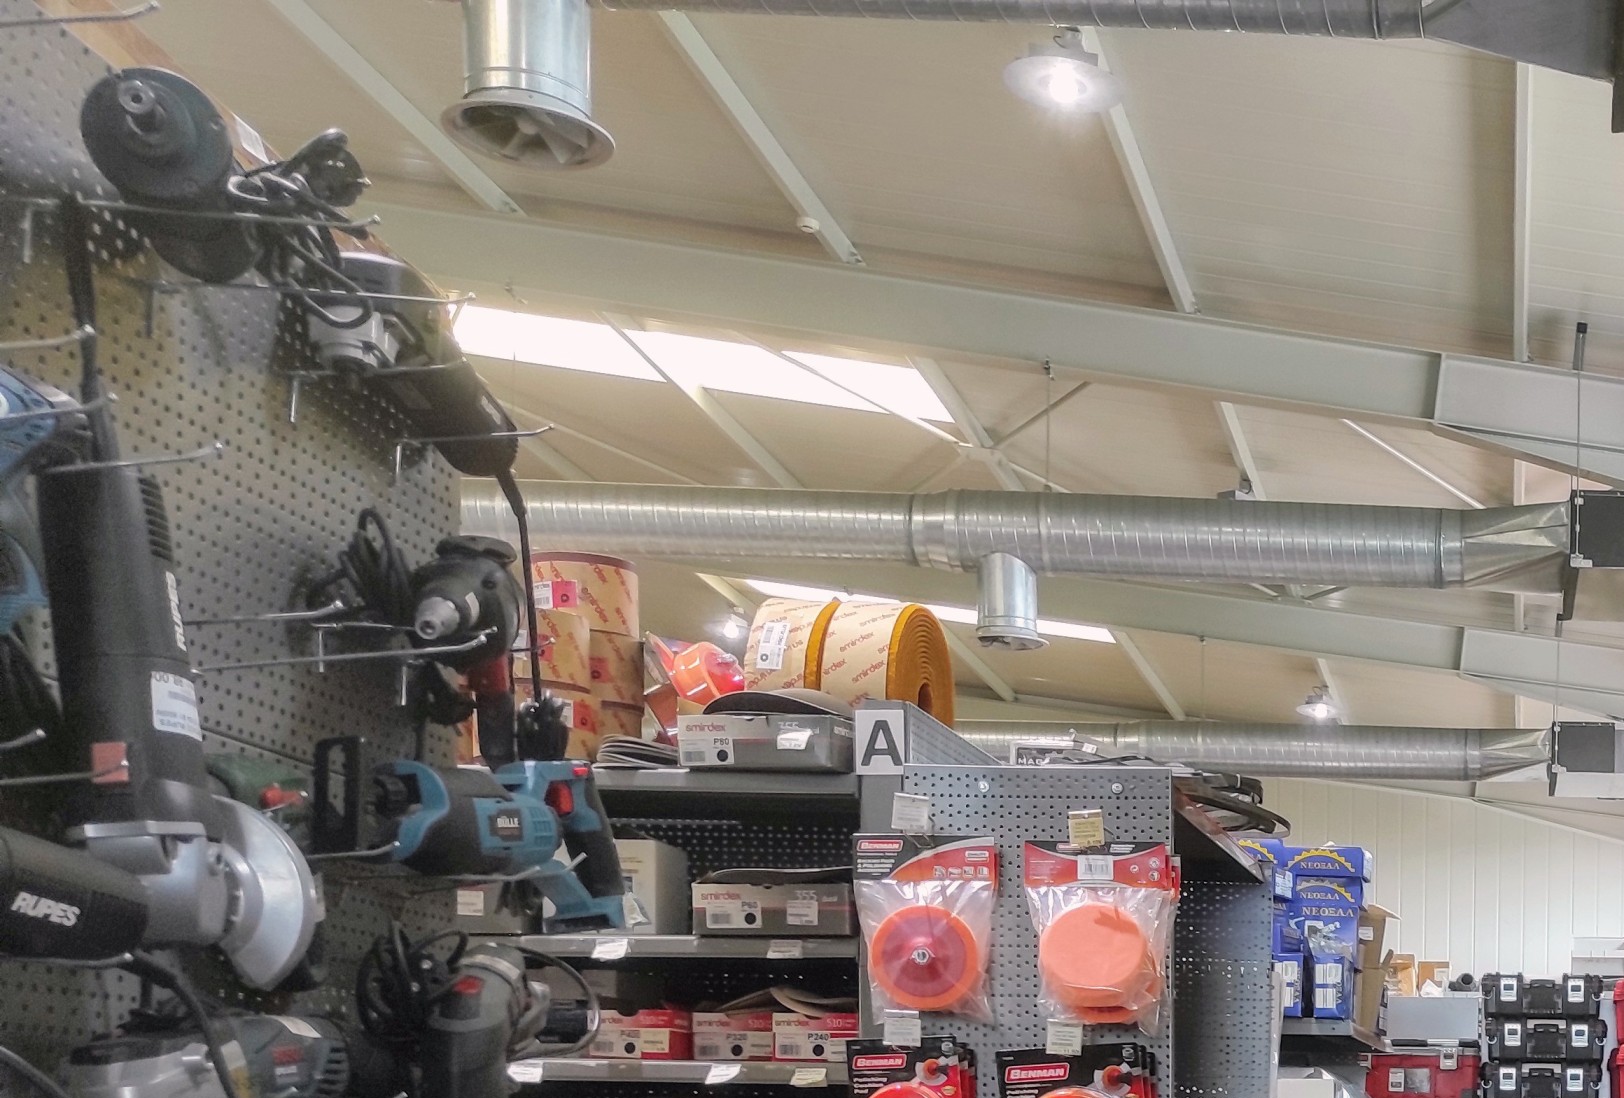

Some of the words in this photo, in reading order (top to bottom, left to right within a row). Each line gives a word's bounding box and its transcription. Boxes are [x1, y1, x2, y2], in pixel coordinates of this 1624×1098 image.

[166, 571, 188, 652] RUPES
[839, 631, 875, 653] smirdex
[852, 659, 886, 684] smirdex
[685, 723, 726, 732] smirdex
[861, 720, 904, 767] A
[860, 840, 900, 851] BENMAN
[700, 891, 741, 901] smirdex
[10, 890, 82, 927] RUPES
[774, 1018, 811, 1028] smirdex
[826, 1018, 843, 1029] 510
[807, 1033, 831, 1042] P240
[854, 1057, 904, 1069] BENMAN
[1008, 1067, 1065, 1081] BENMAN
